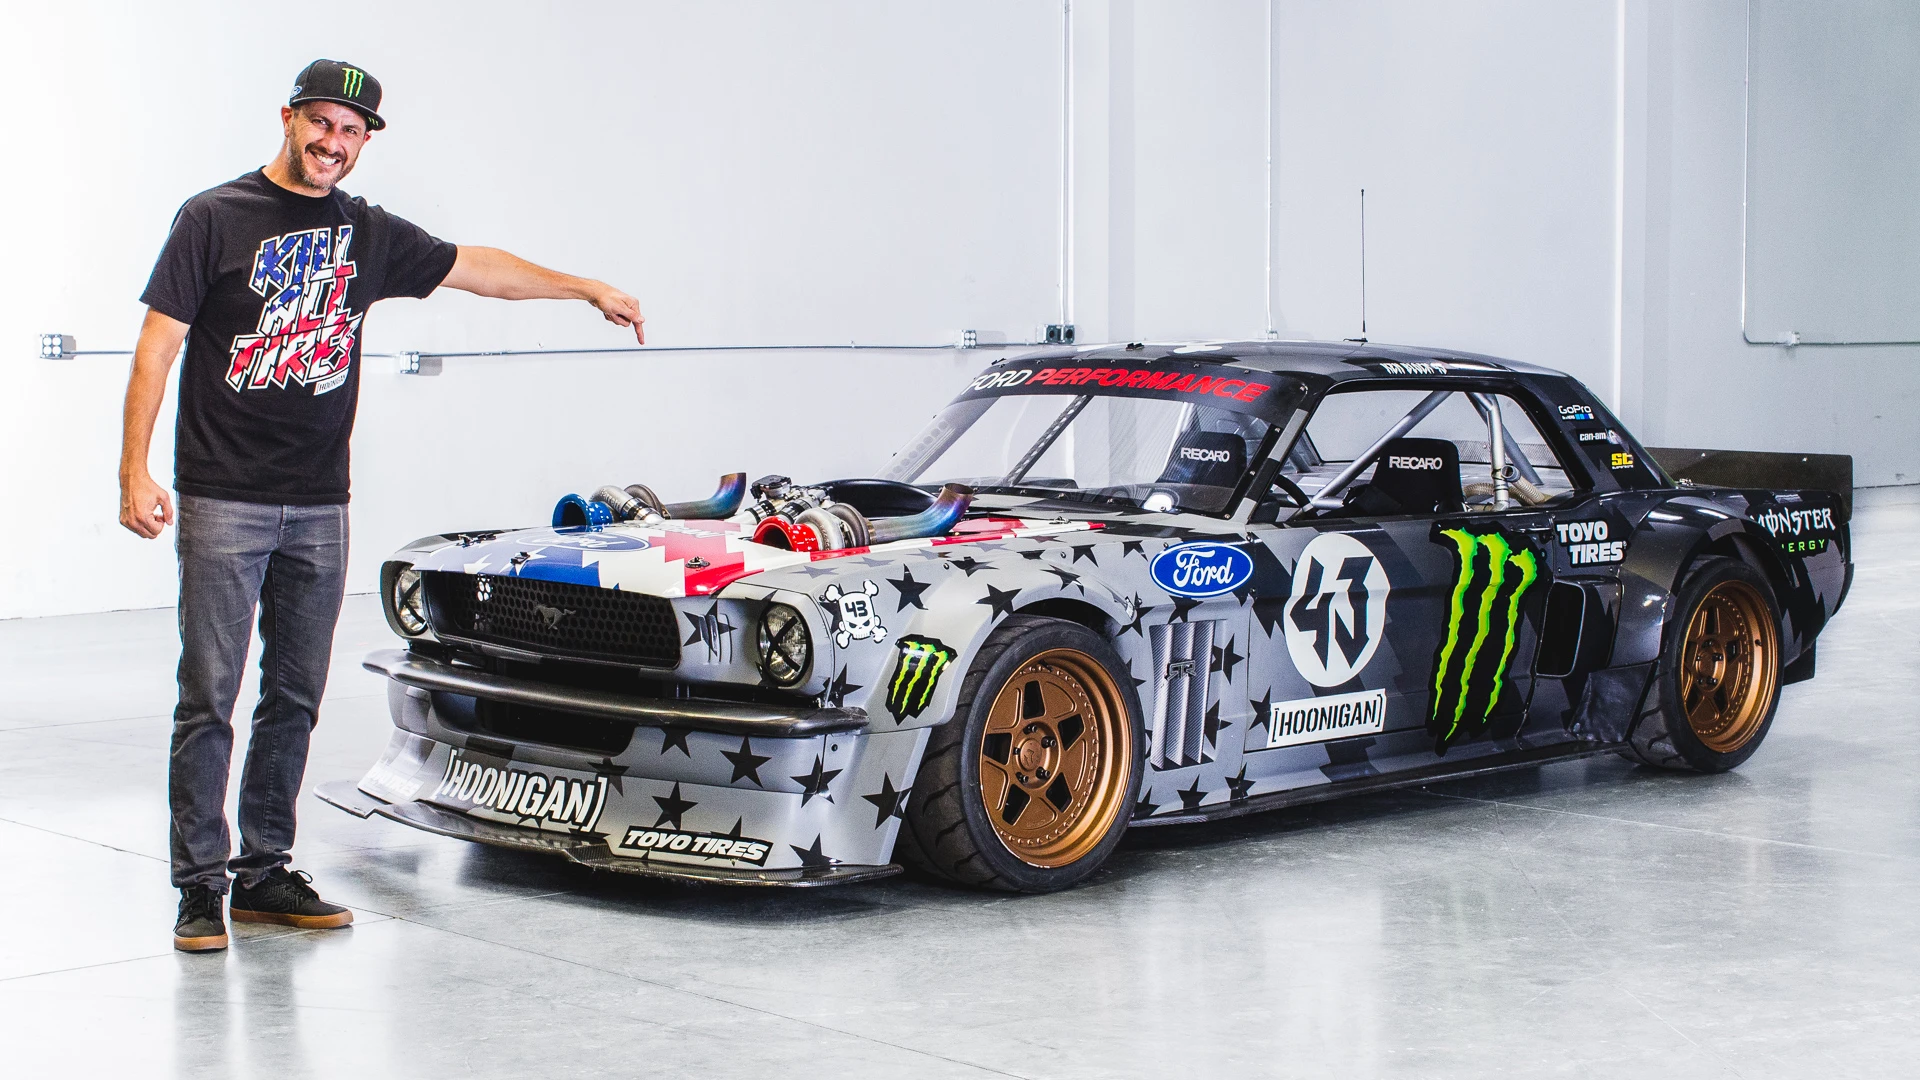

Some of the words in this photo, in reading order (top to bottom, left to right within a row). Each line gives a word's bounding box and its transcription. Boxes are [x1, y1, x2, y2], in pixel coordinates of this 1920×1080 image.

[249, 225, 357, 297] KILL
[256, 276, 352, 337] ALL
[225, 312, 363, 393] TIRES
[961, 368, 1032, 395] FORD
[1025, 368, 1271, 403] PERFORMANCE
[1558, 404, 1592, 414] GoPro
[1180, 447, 1230, 463] RECARO
[1389, 455, 1443, 471] RECARO
[1556, 520, 1609, 543] TOYO
[1173, 549, 1235, 588] Ford
[1569, 541, 1624, 565] TIRES
[844, 600, 869, 618] 43
[1289, 555, 1375, 672] 43
[625, 830, 692, 851] TOYO
[690, 836, 769, 861] TIRES
